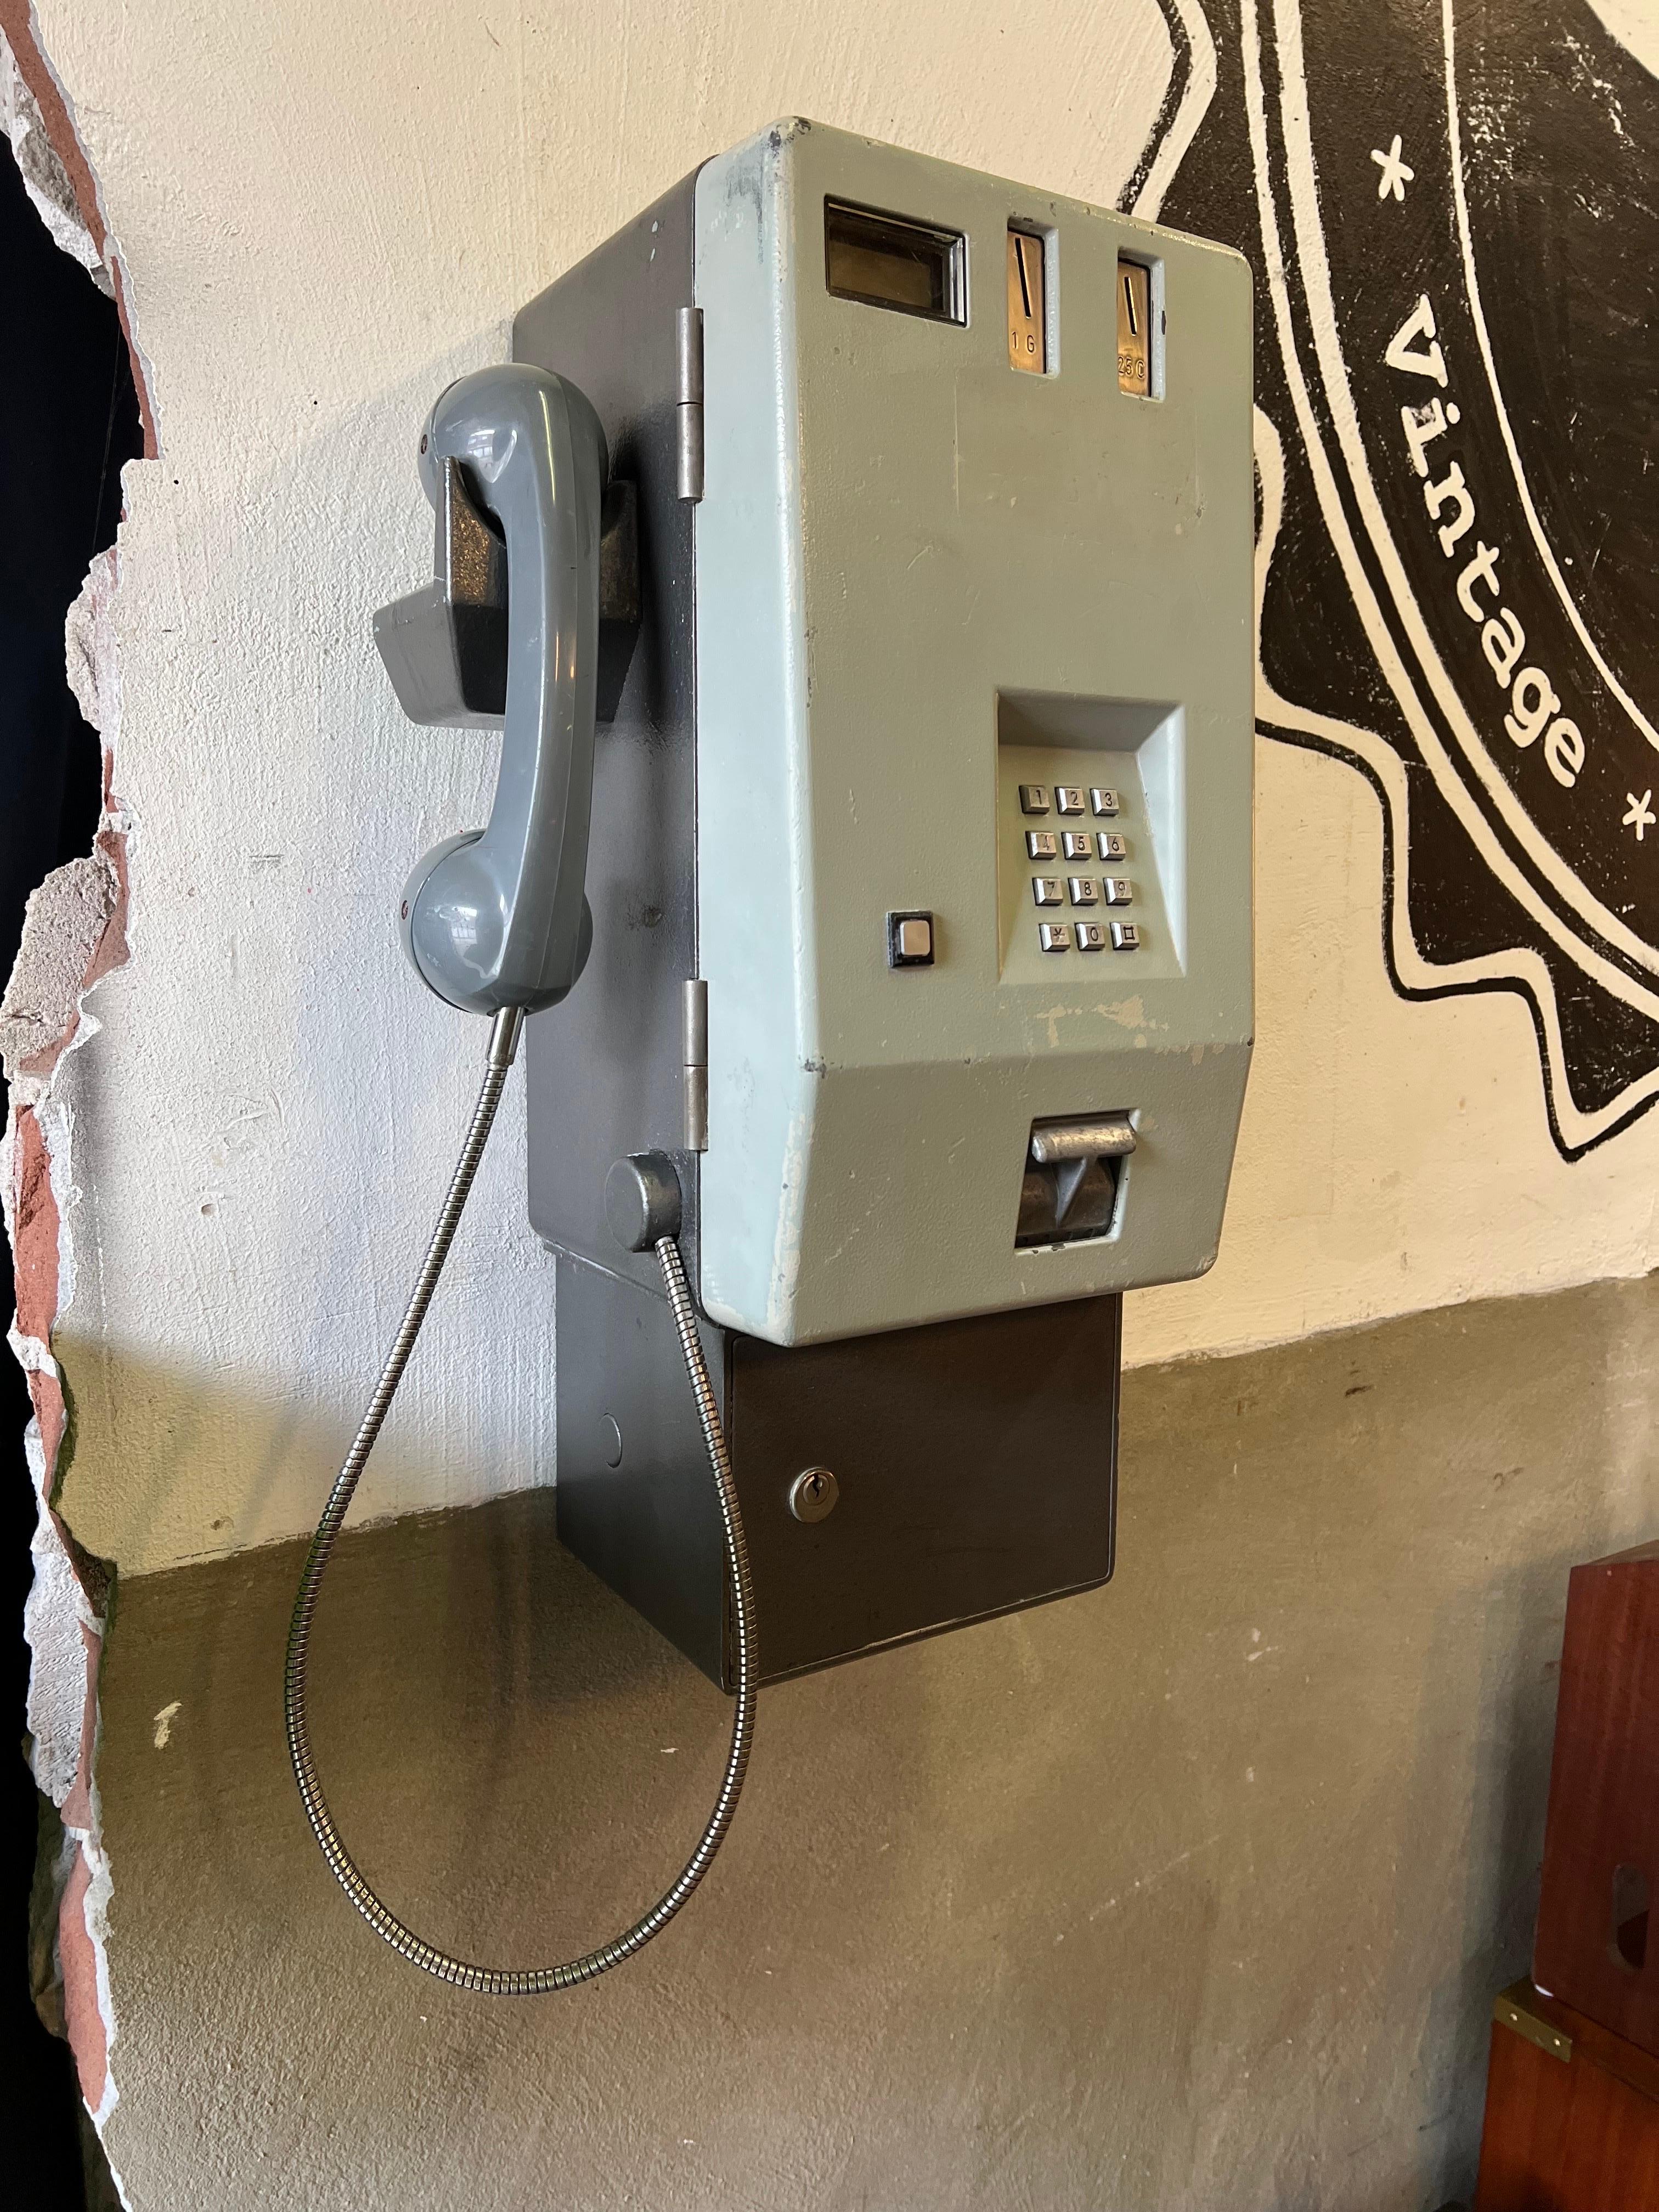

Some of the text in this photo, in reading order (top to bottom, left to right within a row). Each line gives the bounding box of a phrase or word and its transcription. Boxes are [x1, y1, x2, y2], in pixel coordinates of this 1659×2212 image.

[1384, 294, 1584, 787] Vintage
[1035, 789, 1113, 806] 1 2 3
[1043, 836, 1120, 851] 4 5 6
[1047, 881, 1126, 897] 7 8 9
[1090, 927, 1098, 941] 0
